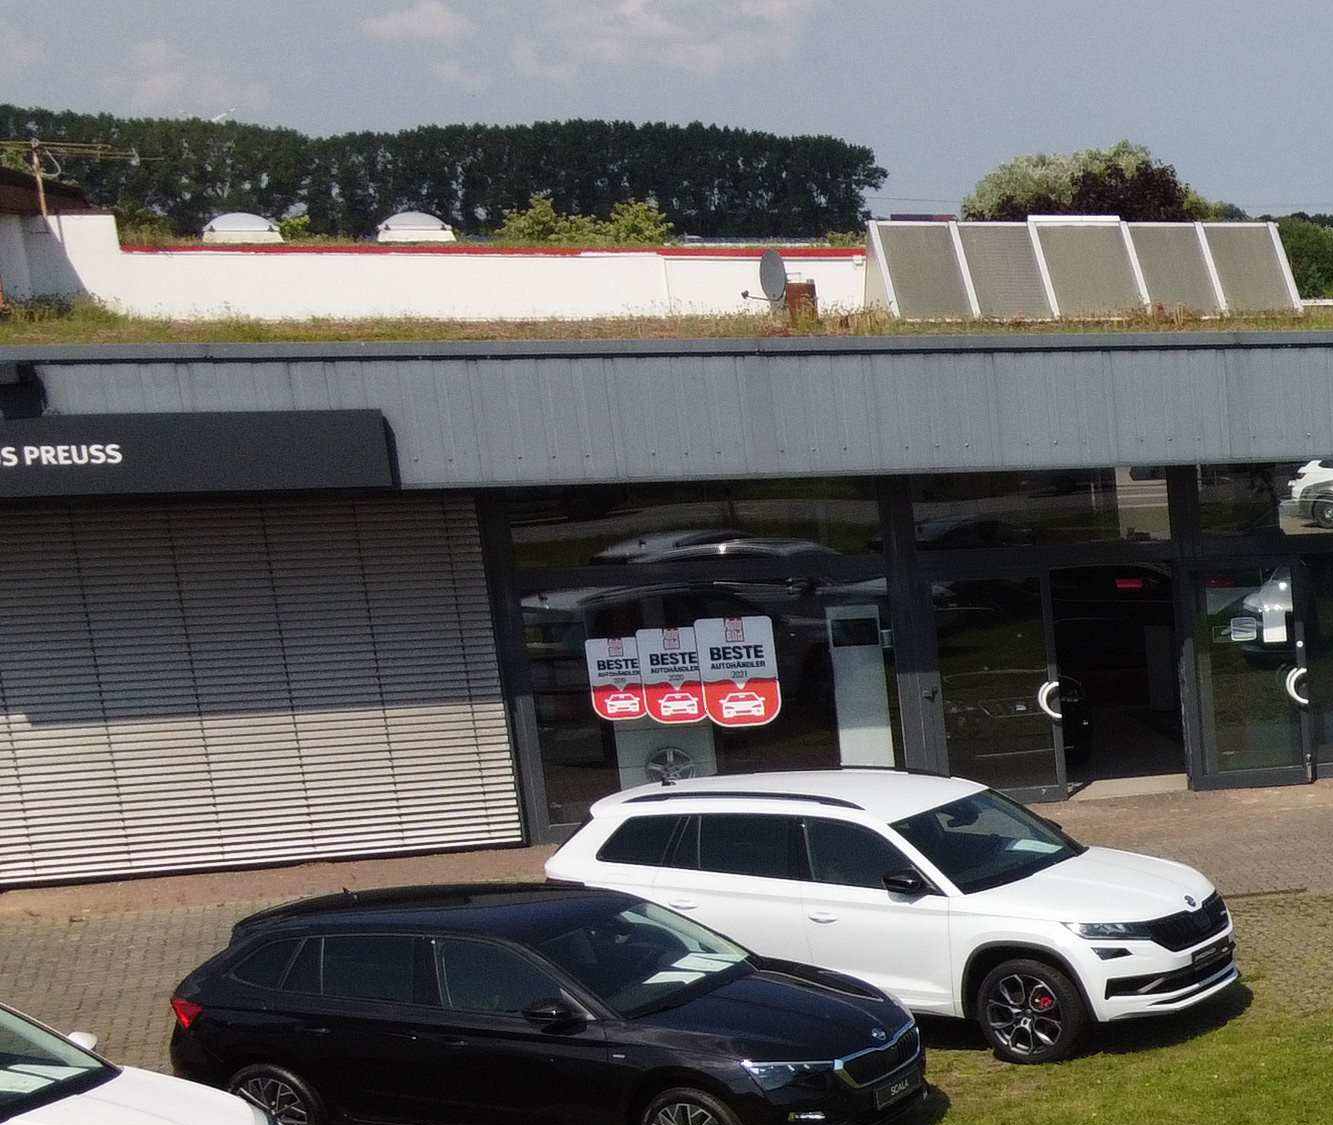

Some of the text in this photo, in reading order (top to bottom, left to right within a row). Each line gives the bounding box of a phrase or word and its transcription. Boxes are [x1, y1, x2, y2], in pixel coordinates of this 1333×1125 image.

[24, 443, 122, 465] PREUSS
[650, 651, 698, 667] BESTE
[709, 645, 764, 661] BESTE
[597, 658, 639, 671] BESTE
[711, 660, 766, 670] AUTOHÄNDLER
